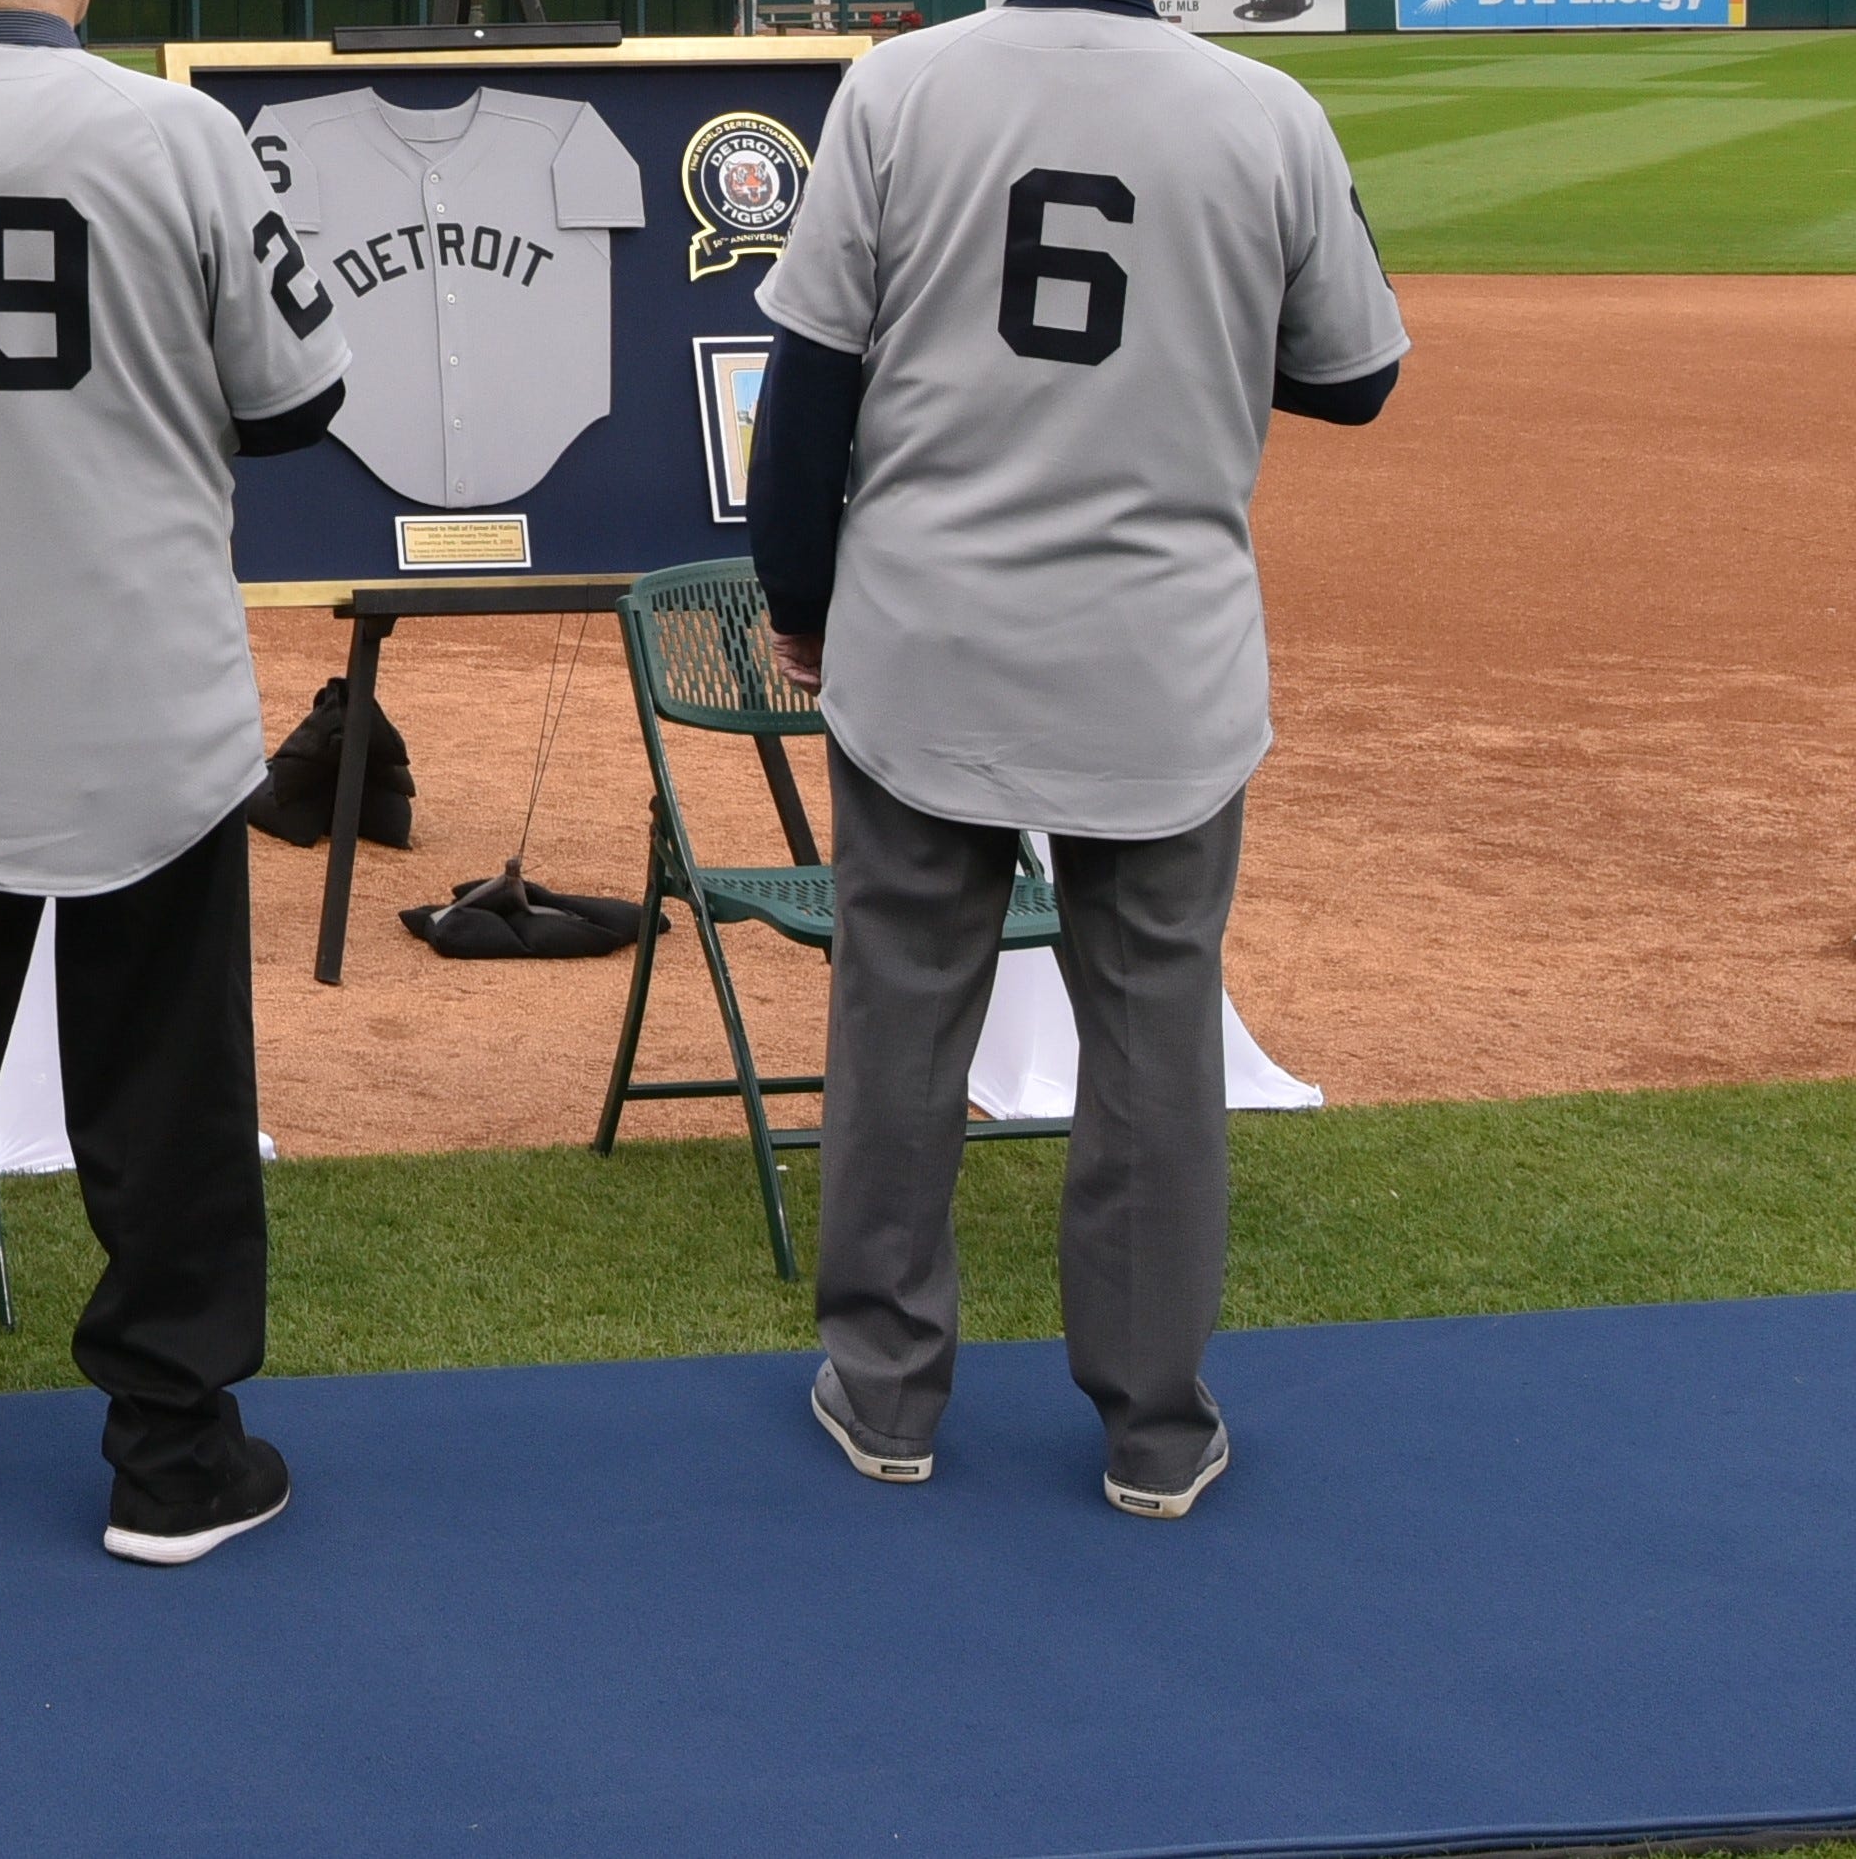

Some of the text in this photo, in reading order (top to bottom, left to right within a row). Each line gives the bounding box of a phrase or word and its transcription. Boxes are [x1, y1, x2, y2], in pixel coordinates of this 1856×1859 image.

[1159, 0, 1199, 12] OF MLB
[697, 127, 723, 153] WORLD
[724, 121, 758, 130] SERIES
[759, 124, 804, 168] CHAMPIONS
[710, 138, 785, 167] DETROIT
[721, 199, 786, 224] TIGERS
[333, 222, 554, 297] DETROIT
[998, 167, 1136, 366] 6
